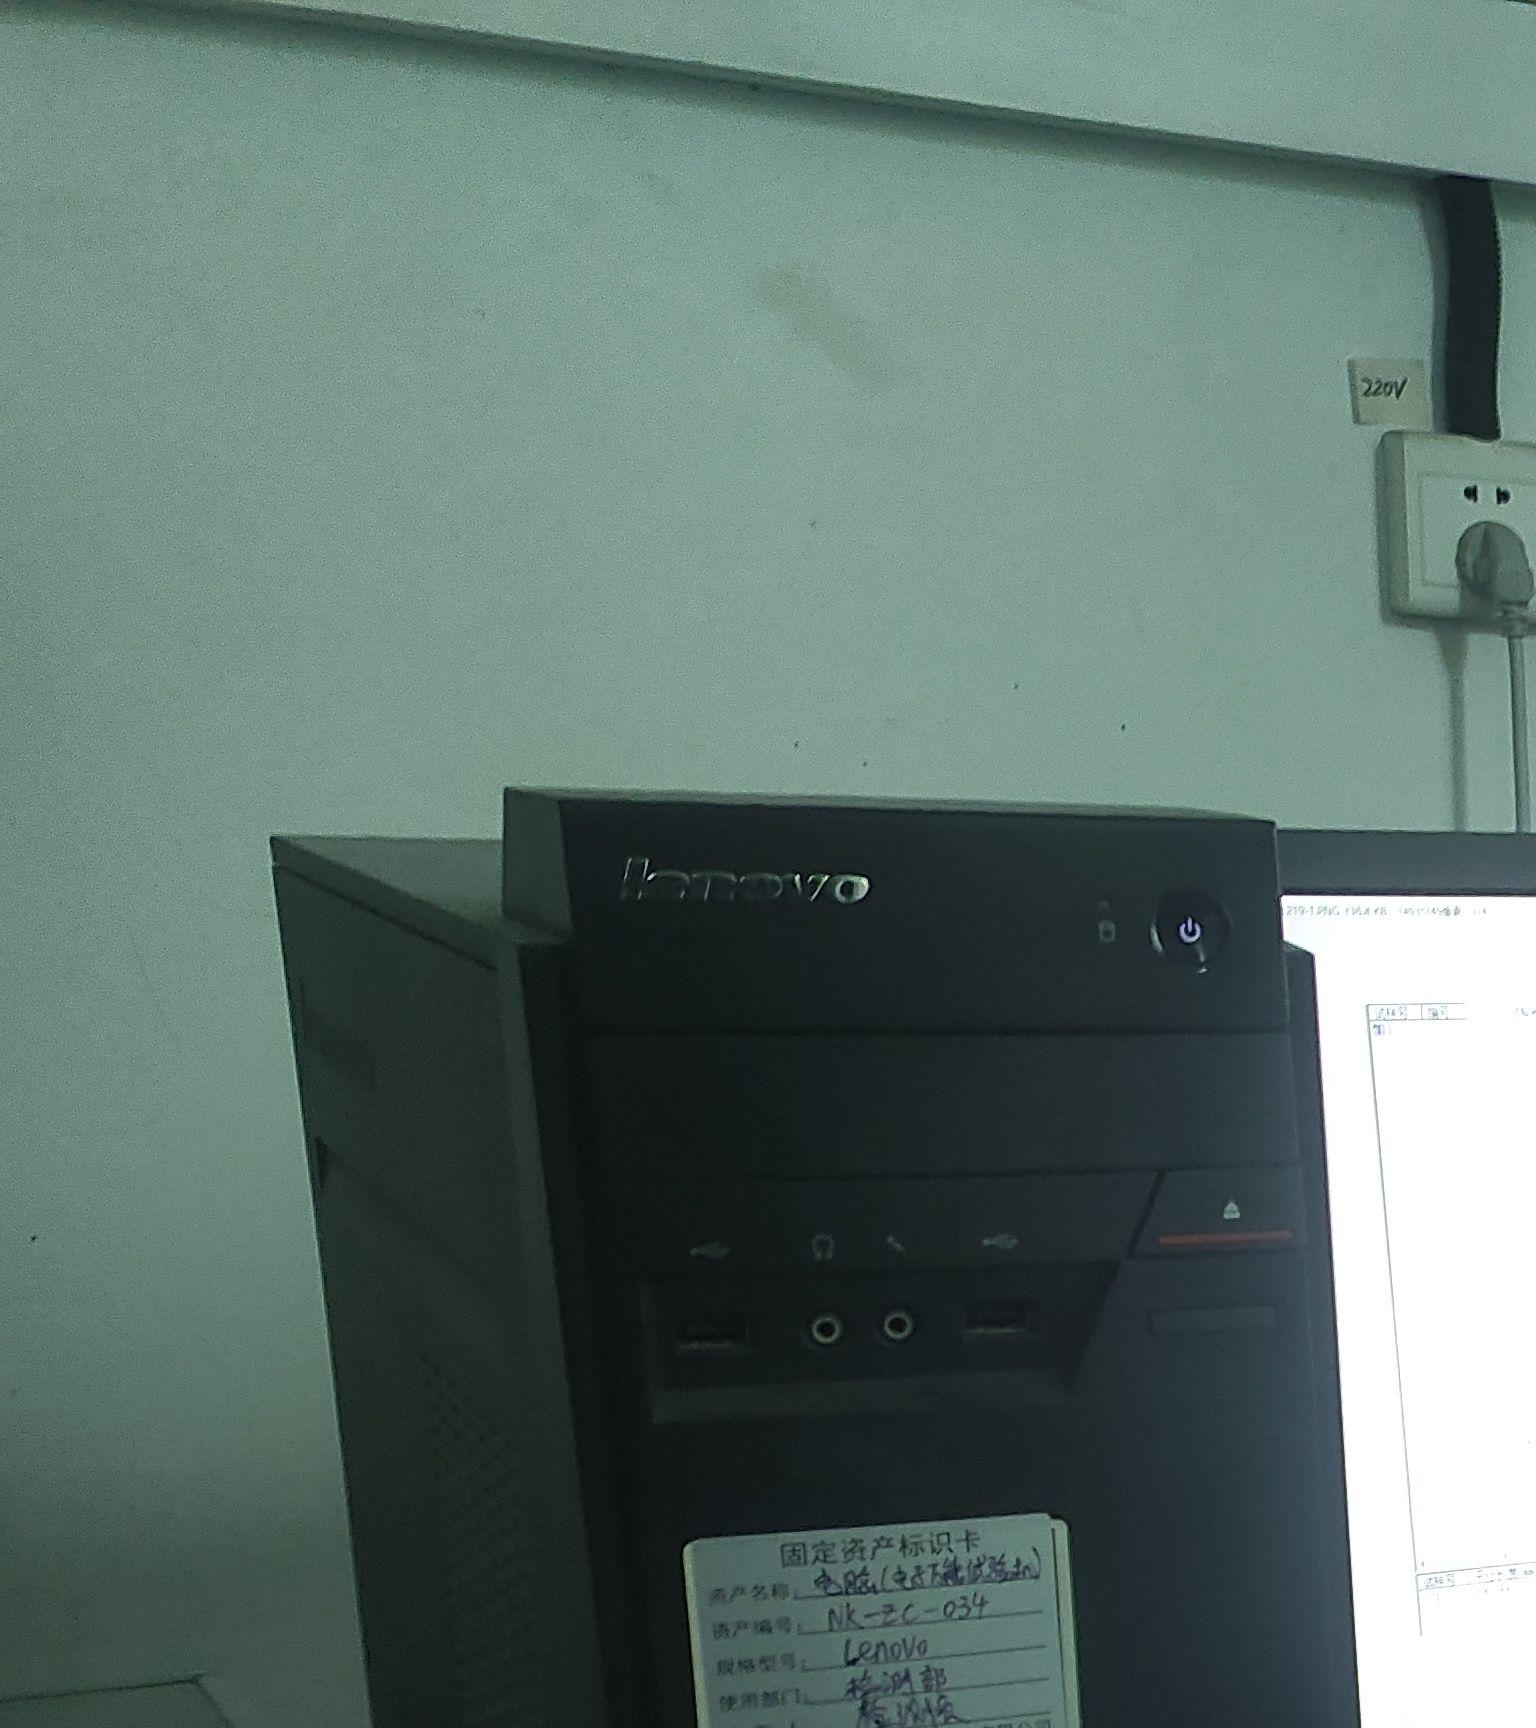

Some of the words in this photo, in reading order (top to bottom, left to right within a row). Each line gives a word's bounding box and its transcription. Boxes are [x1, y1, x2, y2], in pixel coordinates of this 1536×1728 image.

[1361, 377, 1409, 400] 220V
[780, 1527, 981, 1568] 固定资产标识卡
